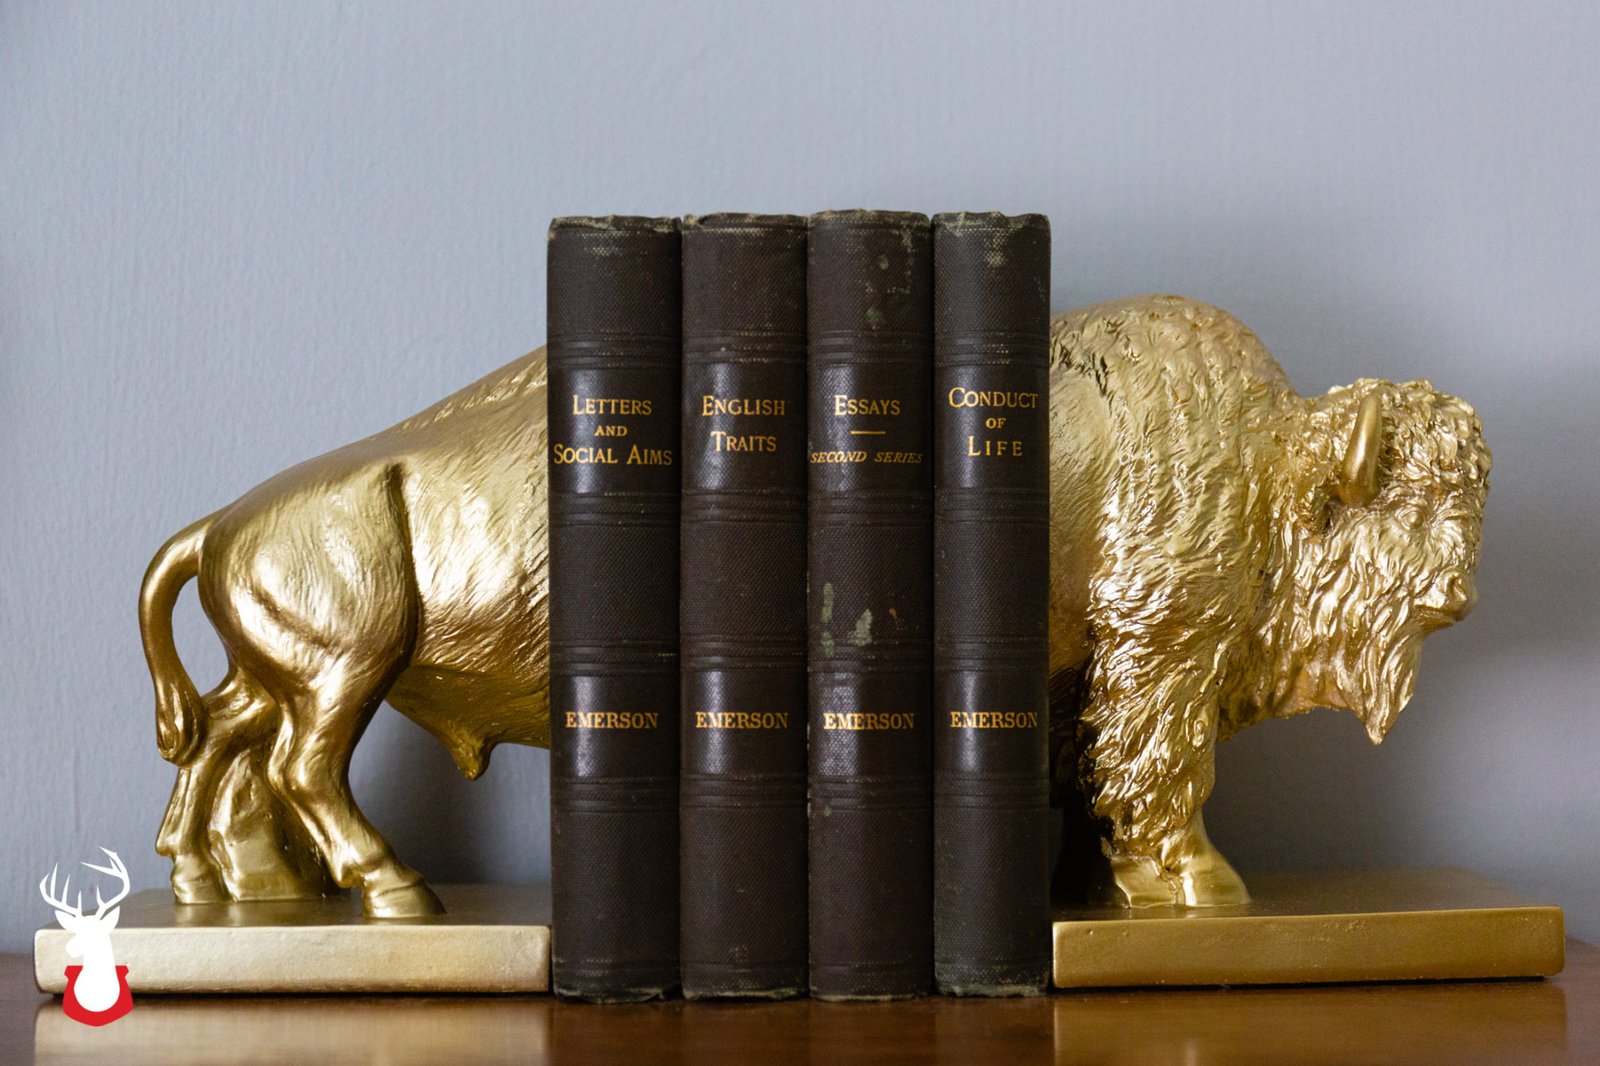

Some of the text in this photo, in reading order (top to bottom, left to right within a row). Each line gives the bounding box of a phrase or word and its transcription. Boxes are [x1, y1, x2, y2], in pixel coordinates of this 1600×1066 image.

[573, 394, 652, 415] LETTERS
[702, 395, 785, 416] ENGLISH
[834, 394, 900, 415] ESSAYS
[949, 387, 1038, 408] CONDUCT
[594, 425, 628, 437] AND
[985, 417, 1006, 429] OF
[710, 431, 777, 452] TRAITS
[967, 435, 1022, 456] LIFE
[553, 443, 672, 465] SOCIAL AIMS
[810, 451, 923, 464] SECOND SERIES
[565, 711, 658, 729] EMERSON
[695, 711, 789, 729] EMERSON
[823, 712, 914, 730] EMERSON
[950, 711, 1038, 728] EMERSON
